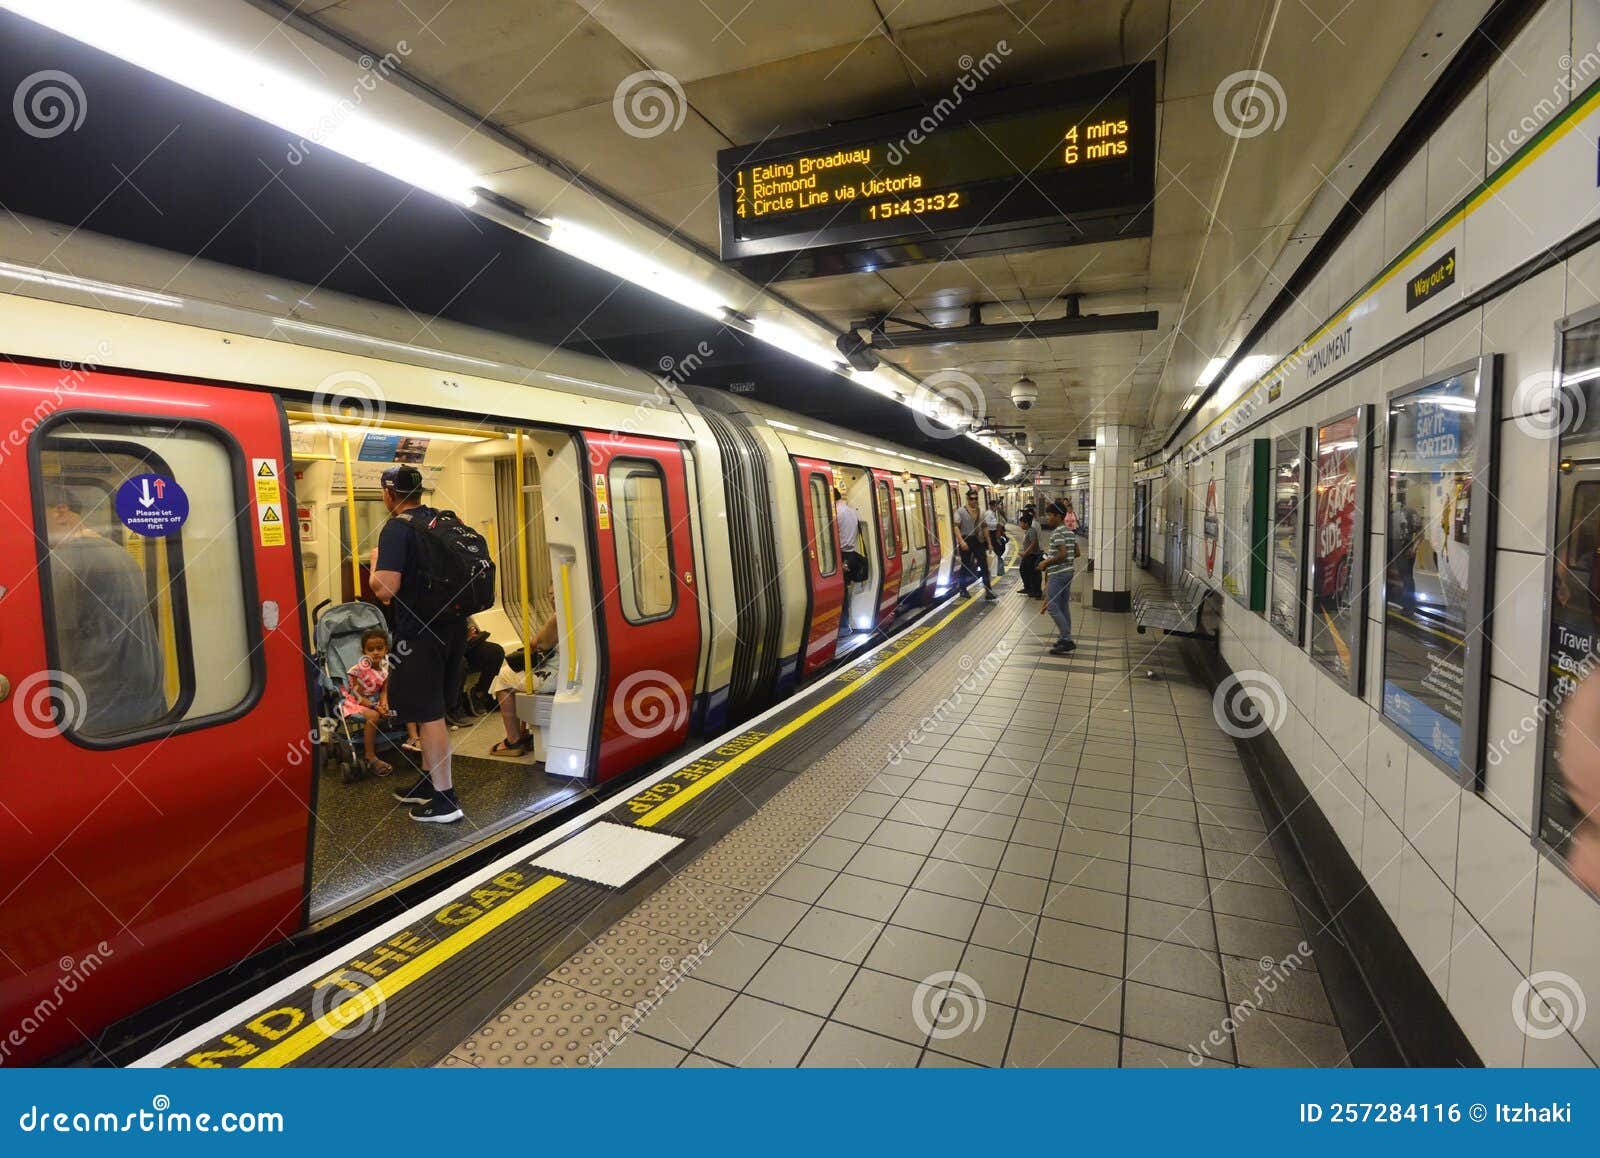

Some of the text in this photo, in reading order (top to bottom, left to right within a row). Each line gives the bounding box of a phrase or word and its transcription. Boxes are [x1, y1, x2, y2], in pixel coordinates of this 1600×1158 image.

[737, 120, 1128, 186] 1 Ealing Broadway 4 mins
[736, 140, 1128, 203] 2 Richmond 6 mins
[736, 174, 922, 218] 4 Circle Line via Victoria
[869, 192, 960, 220] 15:43:32
[1414, 265, 1446, 298] Way out
[1306, 326, 1353, 378] MONUMENT
[1417, 415, 1434, 438] SAY
[1415, 433, 1458, 460] SORTED.
[1321, 516, 1342, 558] SIDE
[1558, 626, 1593, 653] Travel
[671, 758, 725, 781] THE
[626, 782, 681, 814] GAP
[312, 929, 440, 993] THE
[434, 870, 527, 927] GAP
